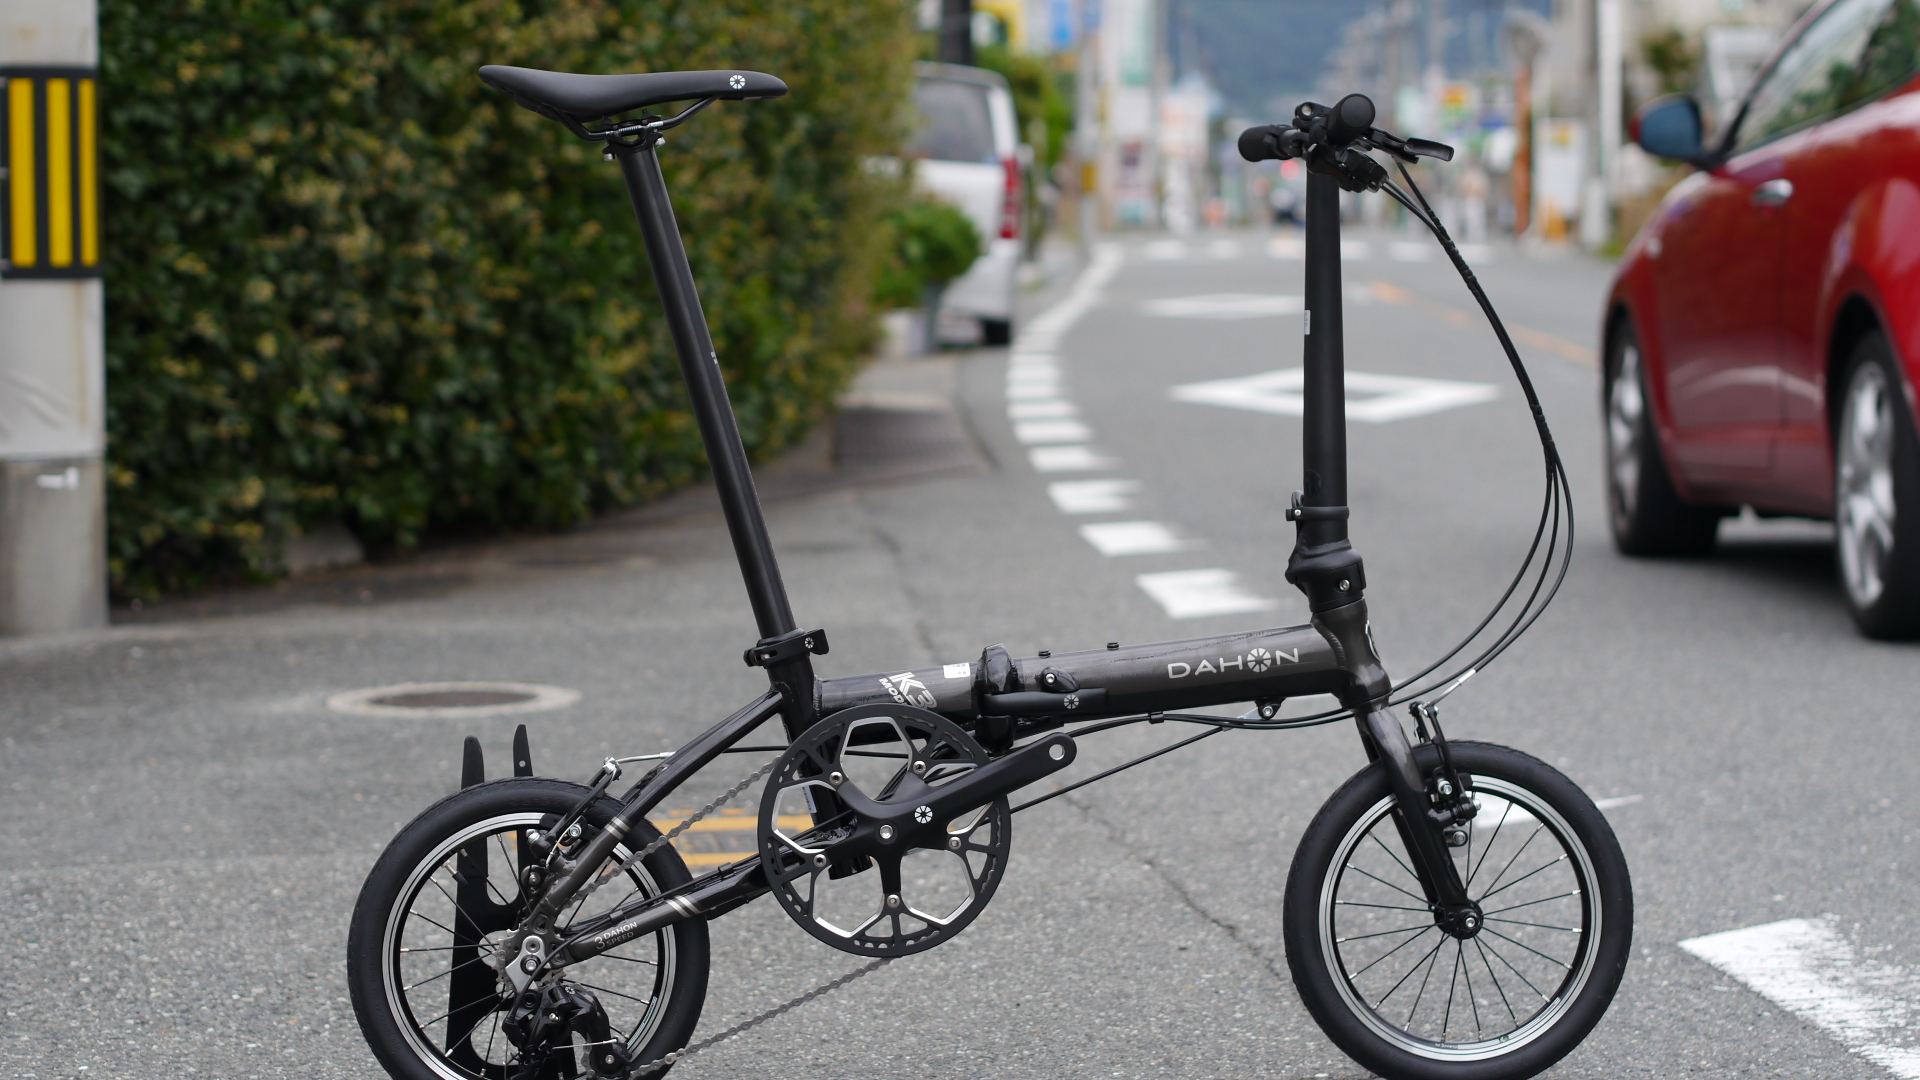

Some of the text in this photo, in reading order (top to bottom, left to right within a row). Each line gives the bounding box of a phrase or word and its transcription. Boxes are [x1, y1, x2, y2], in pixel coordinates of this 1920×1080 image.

[1167, 648, 1299, 679] DAHON
[888, 671, 937, 710] K3
[603, 921, 637, 940] DAHON
[606, 931, 634, 947] SPEED
[594, 936, 606, 950] 3
